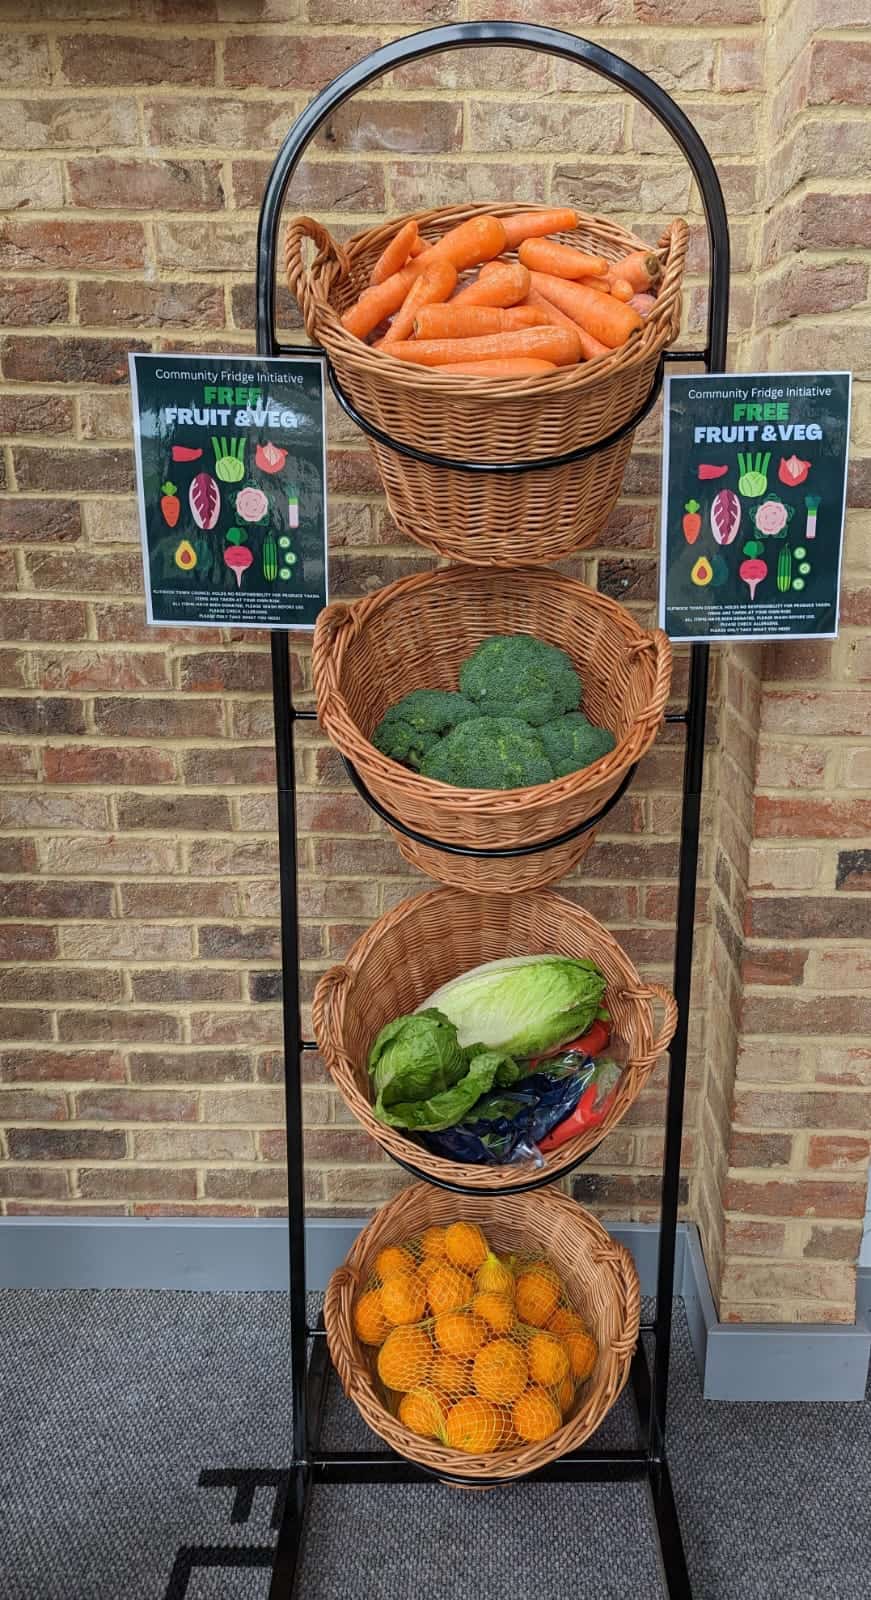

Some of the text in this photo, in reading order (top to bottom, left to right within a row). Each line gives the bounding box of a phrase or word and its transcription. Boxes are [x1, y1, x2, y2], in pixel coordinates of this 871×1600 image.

[155, 369, 304, 384] Community Fridge Initiative
[203, 386, 262, 405] FREE
[688, 386, 832, 400] Community Fridge Initiative
[165, 408, 231, 426] FRUIT
[733, 402, 789, 421] FREE
[694, 425, 758, 443] FRUIT
